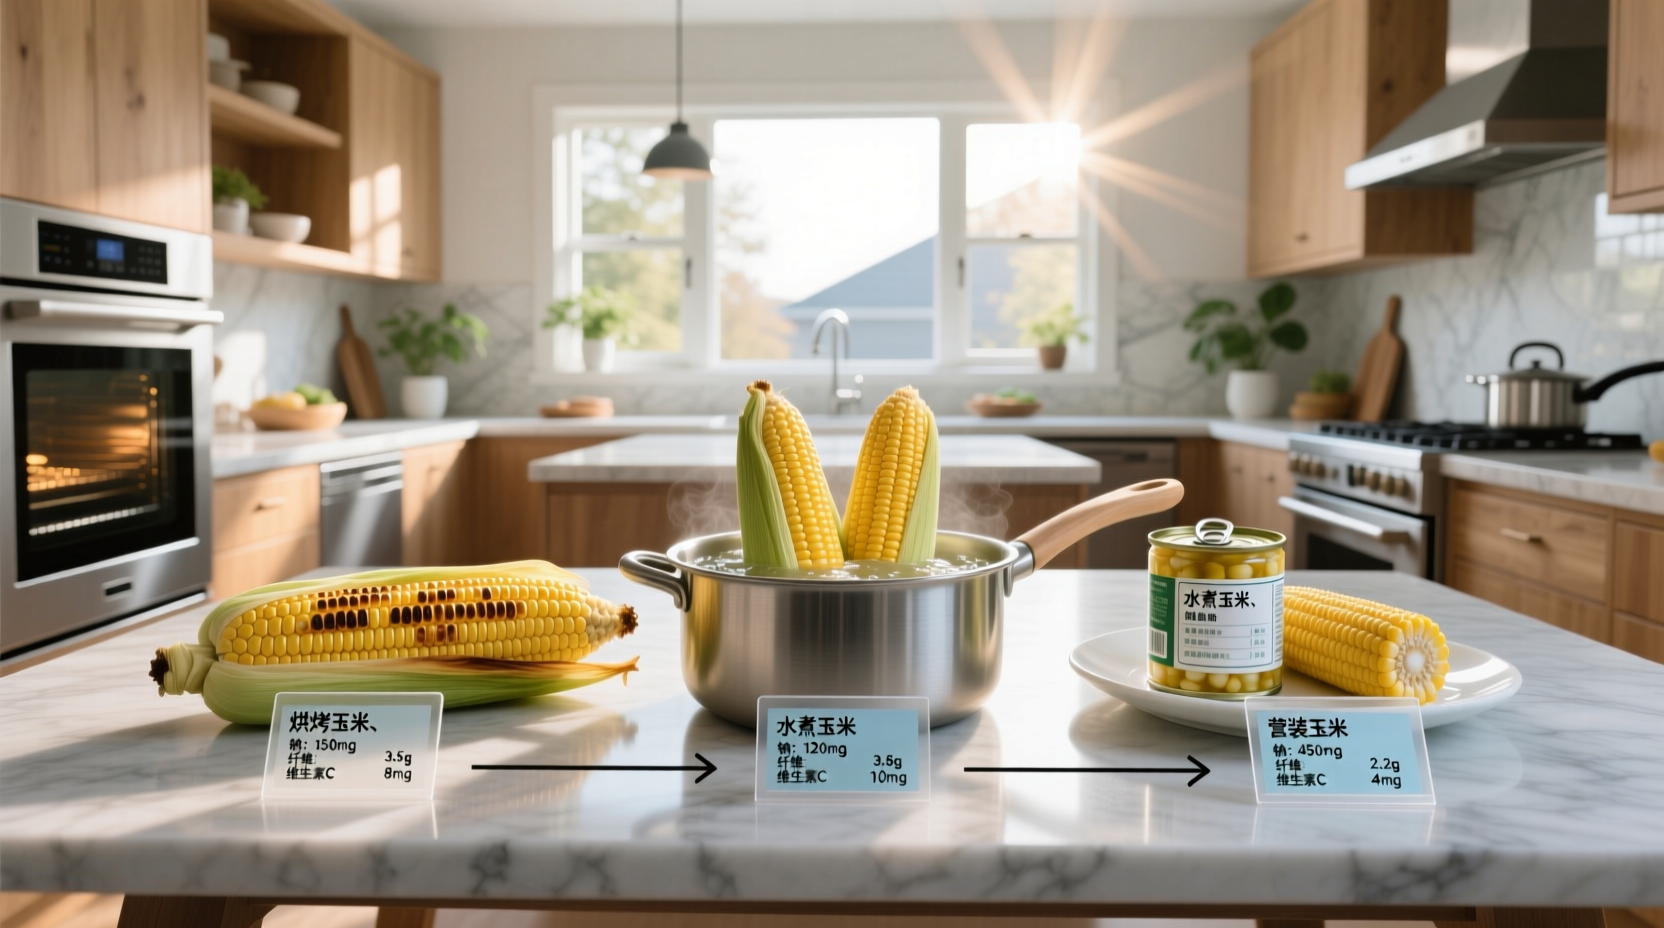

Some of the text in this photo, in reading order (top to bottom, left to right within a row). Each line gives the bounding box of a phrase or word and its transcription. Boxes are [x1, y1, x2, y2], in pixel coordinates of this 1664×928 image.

[777, 715, 857, 737] 水煮玉米
[315, 739, 357, 754] 150mg
[803, 742, 847, 758] 120mg
[384, 751, 412, 767] 3.5g
[1370, 757, 1400, 773] 2.2g
[384, 767, 412, 783] 8mg
[870, 769, 907, 786] 10mg
[1371, 773, 1402, 789] 4mg
